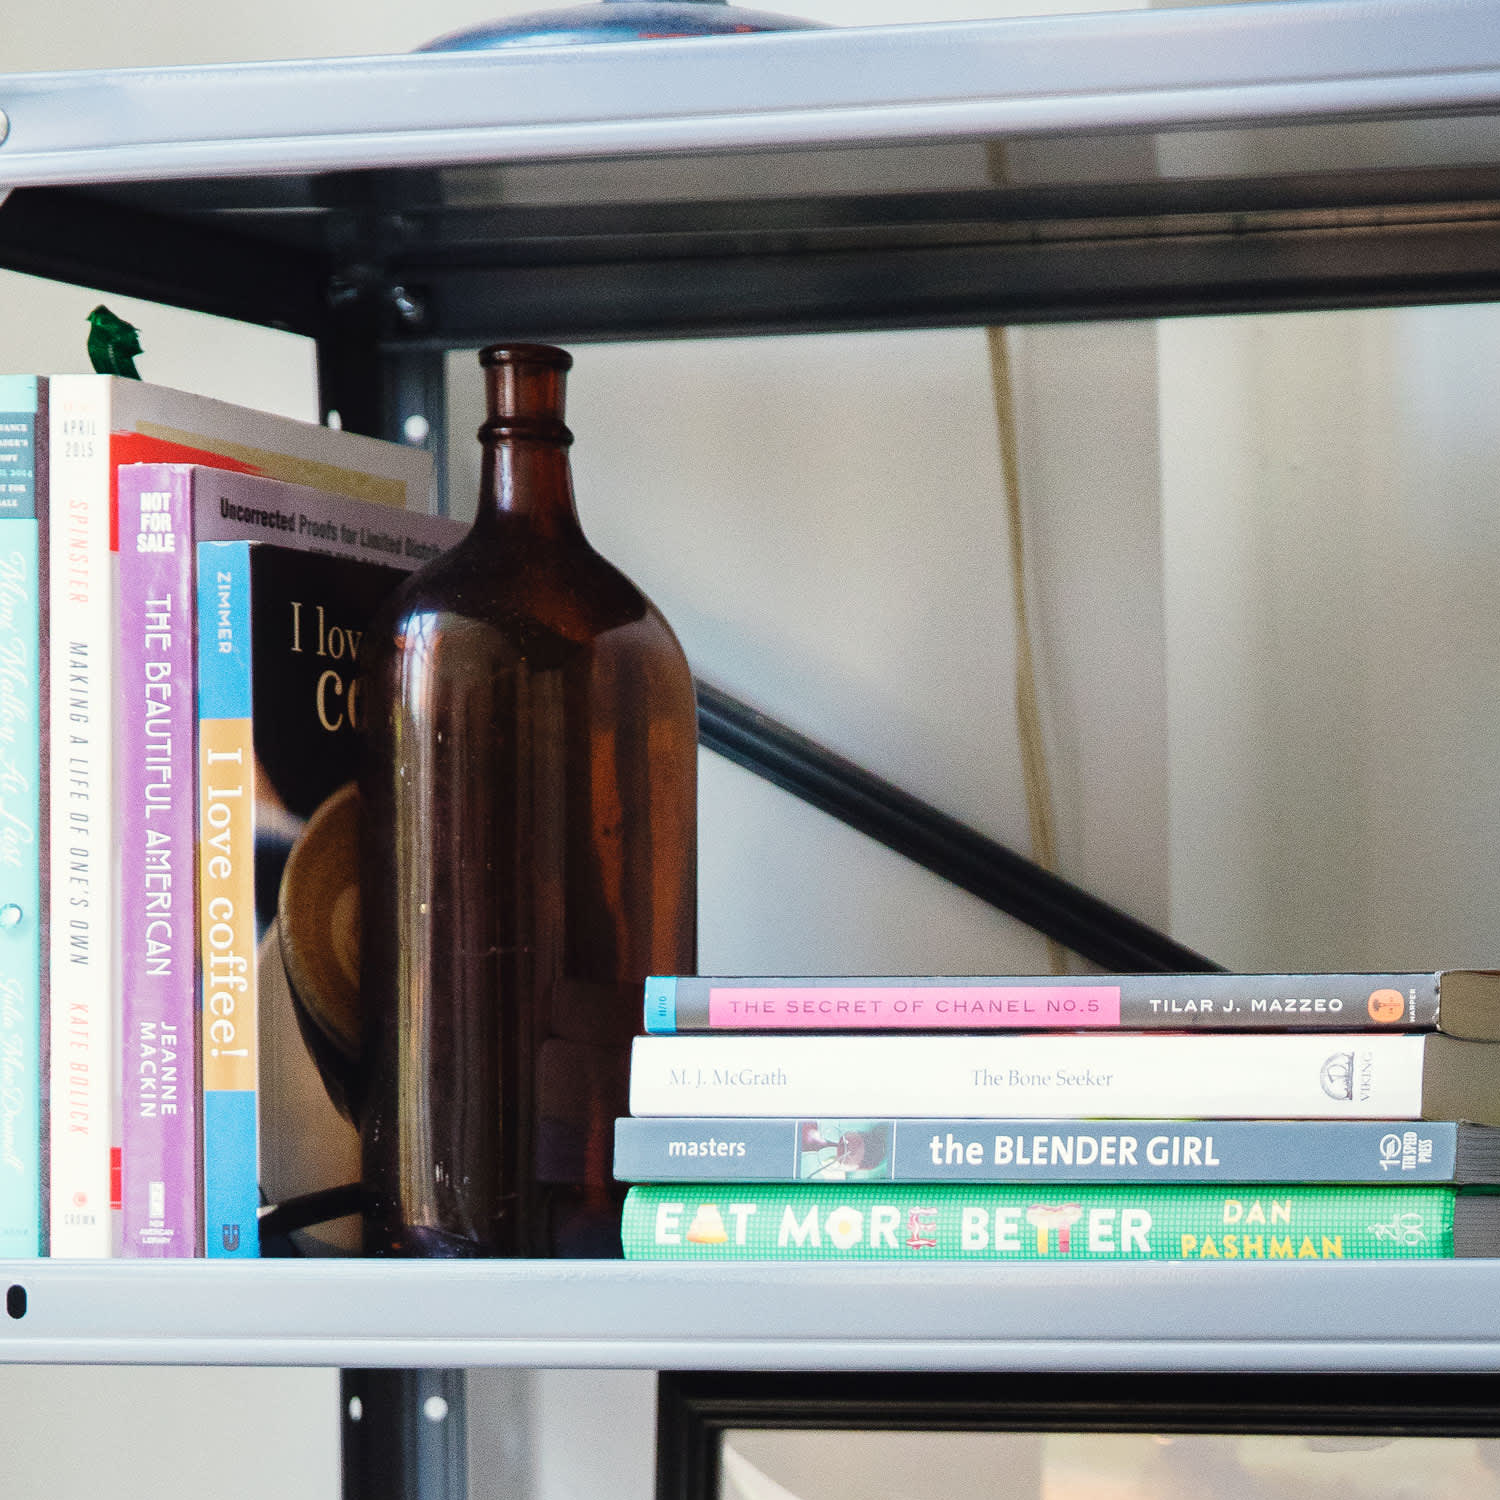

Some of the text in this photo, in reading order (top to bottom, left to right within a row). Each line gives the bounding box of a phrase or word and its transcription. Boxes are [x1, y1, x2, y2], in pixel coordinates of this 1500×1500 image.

[139, 492, 172, 513] NOT
[140, 514, 172, 533] FOR
[219, 497, 296, 532] Uncorrected
[298, 514, 338, 541] Proofs
[67, 499, 89, 604] SPINSTER
[136, 533, 175, 554] SALE
[217, 571, 233, 654] ZIMMER
[290, 601, 303, 653] I
[69, 641, 89, 966] MAKING A LIFE OF ONE'S OWN
[144, 594, 172, 976] THE BEAUTIFUL AMERICAN
[208, 748, 248, 1058] I love coffee!
[728, 998, 1344, 1014] THE SECRET OF CHANEL NO.5 TILAR J. MAZZEO
[1408, 988, 1417, 1023] HARPER
[69, 1003, 89, 1136] KATE BOLICK
[140, 1022, 158, 1118] MACKIN
[161, 1021, 177, 1116] JEANNE
[669, 1067, 1113, 1087] M. J. McGrath The Bone Seeker
[1359, 1052, 1373, 1102] VIKING
[668, 1134, 1220, 1166] masters the BLENDER GIRL
[1402, 1131, 1418, 1170] TEN SPEED
[1417, 1138, 1433, 1164] PRESS
[654, 1201, 1152, 1254] EAT MORE BETTER
[1223, 1199, 1292, 1225] DAN
[1180, 1235, 1343, 1259] PASHMAN
